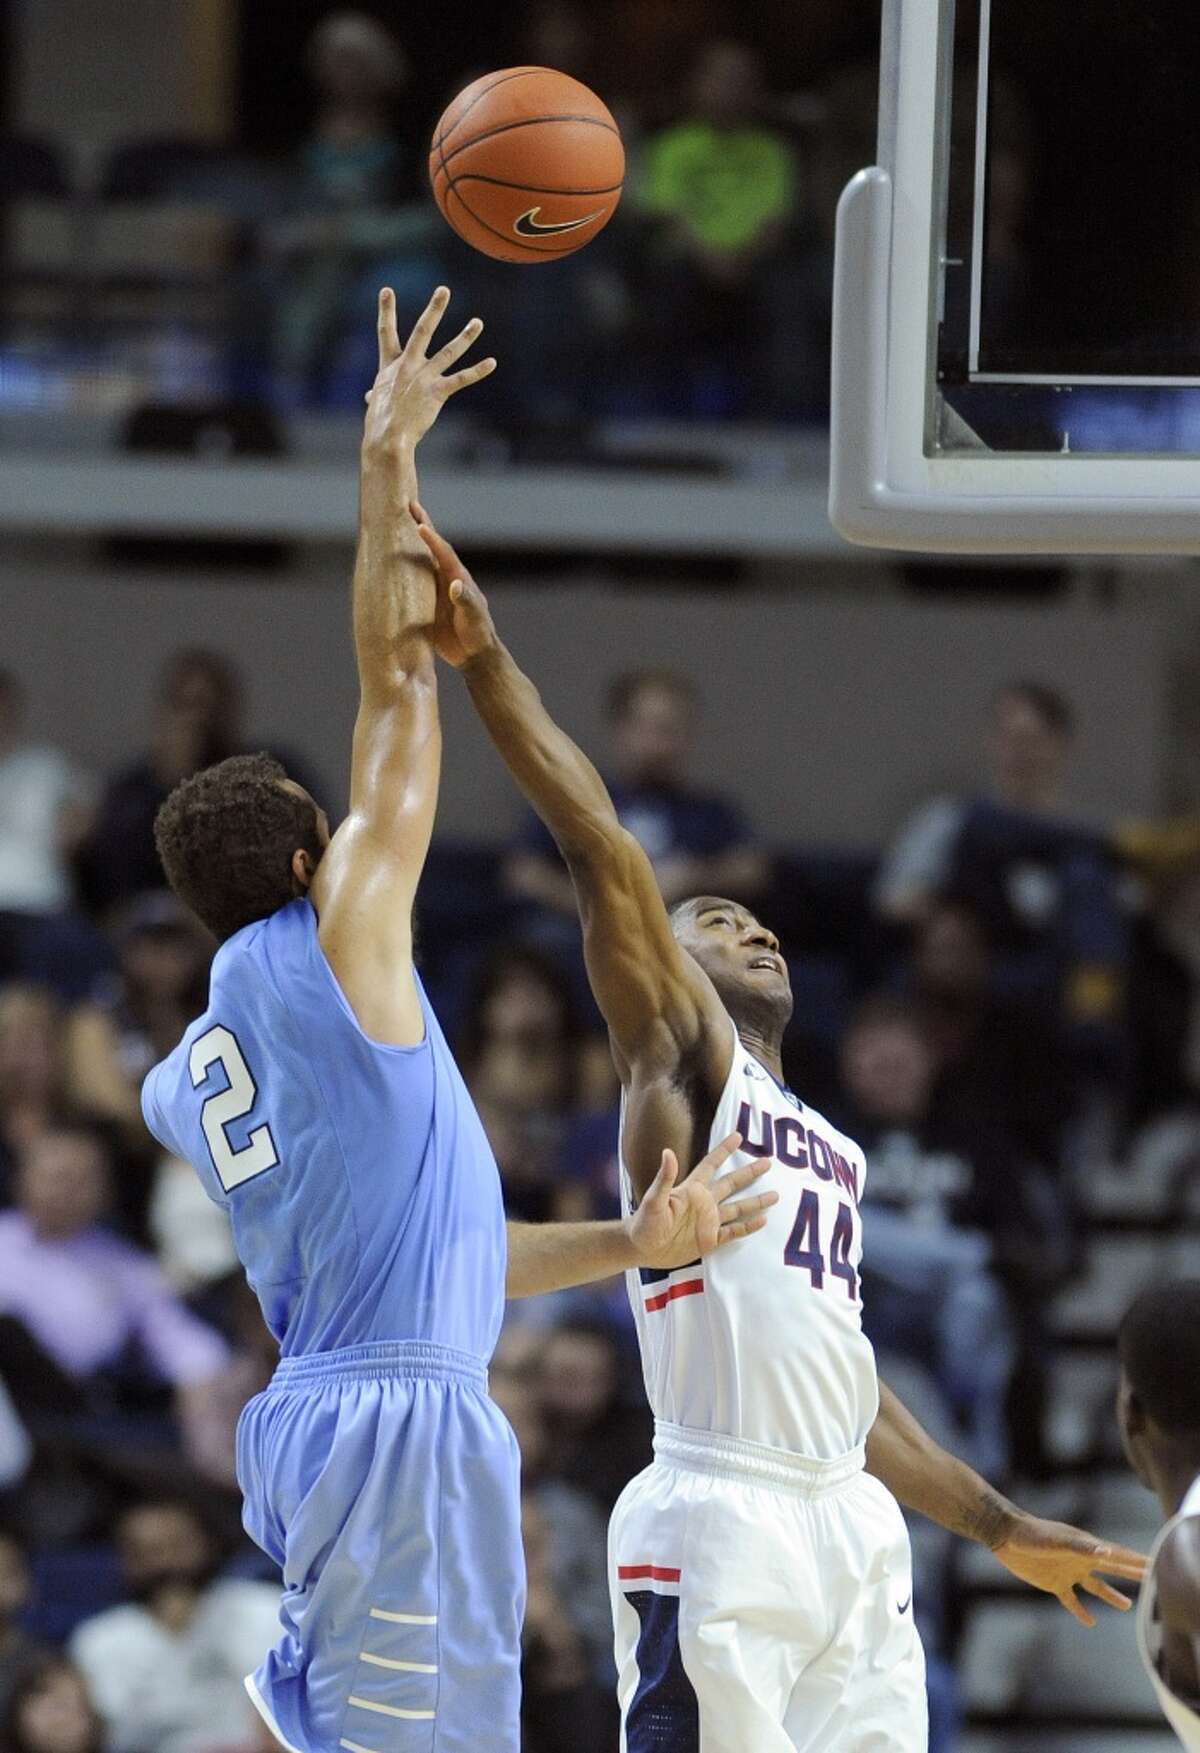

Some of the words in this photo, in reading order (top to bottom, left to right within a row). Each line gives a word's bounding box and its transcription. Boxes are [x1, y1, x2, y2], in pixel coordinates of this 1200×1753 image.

[188, 1023, 280, 1195] 2
[737, 1101, 858, 1203] UCONN
[784, 1188, 857, 1301] 44
